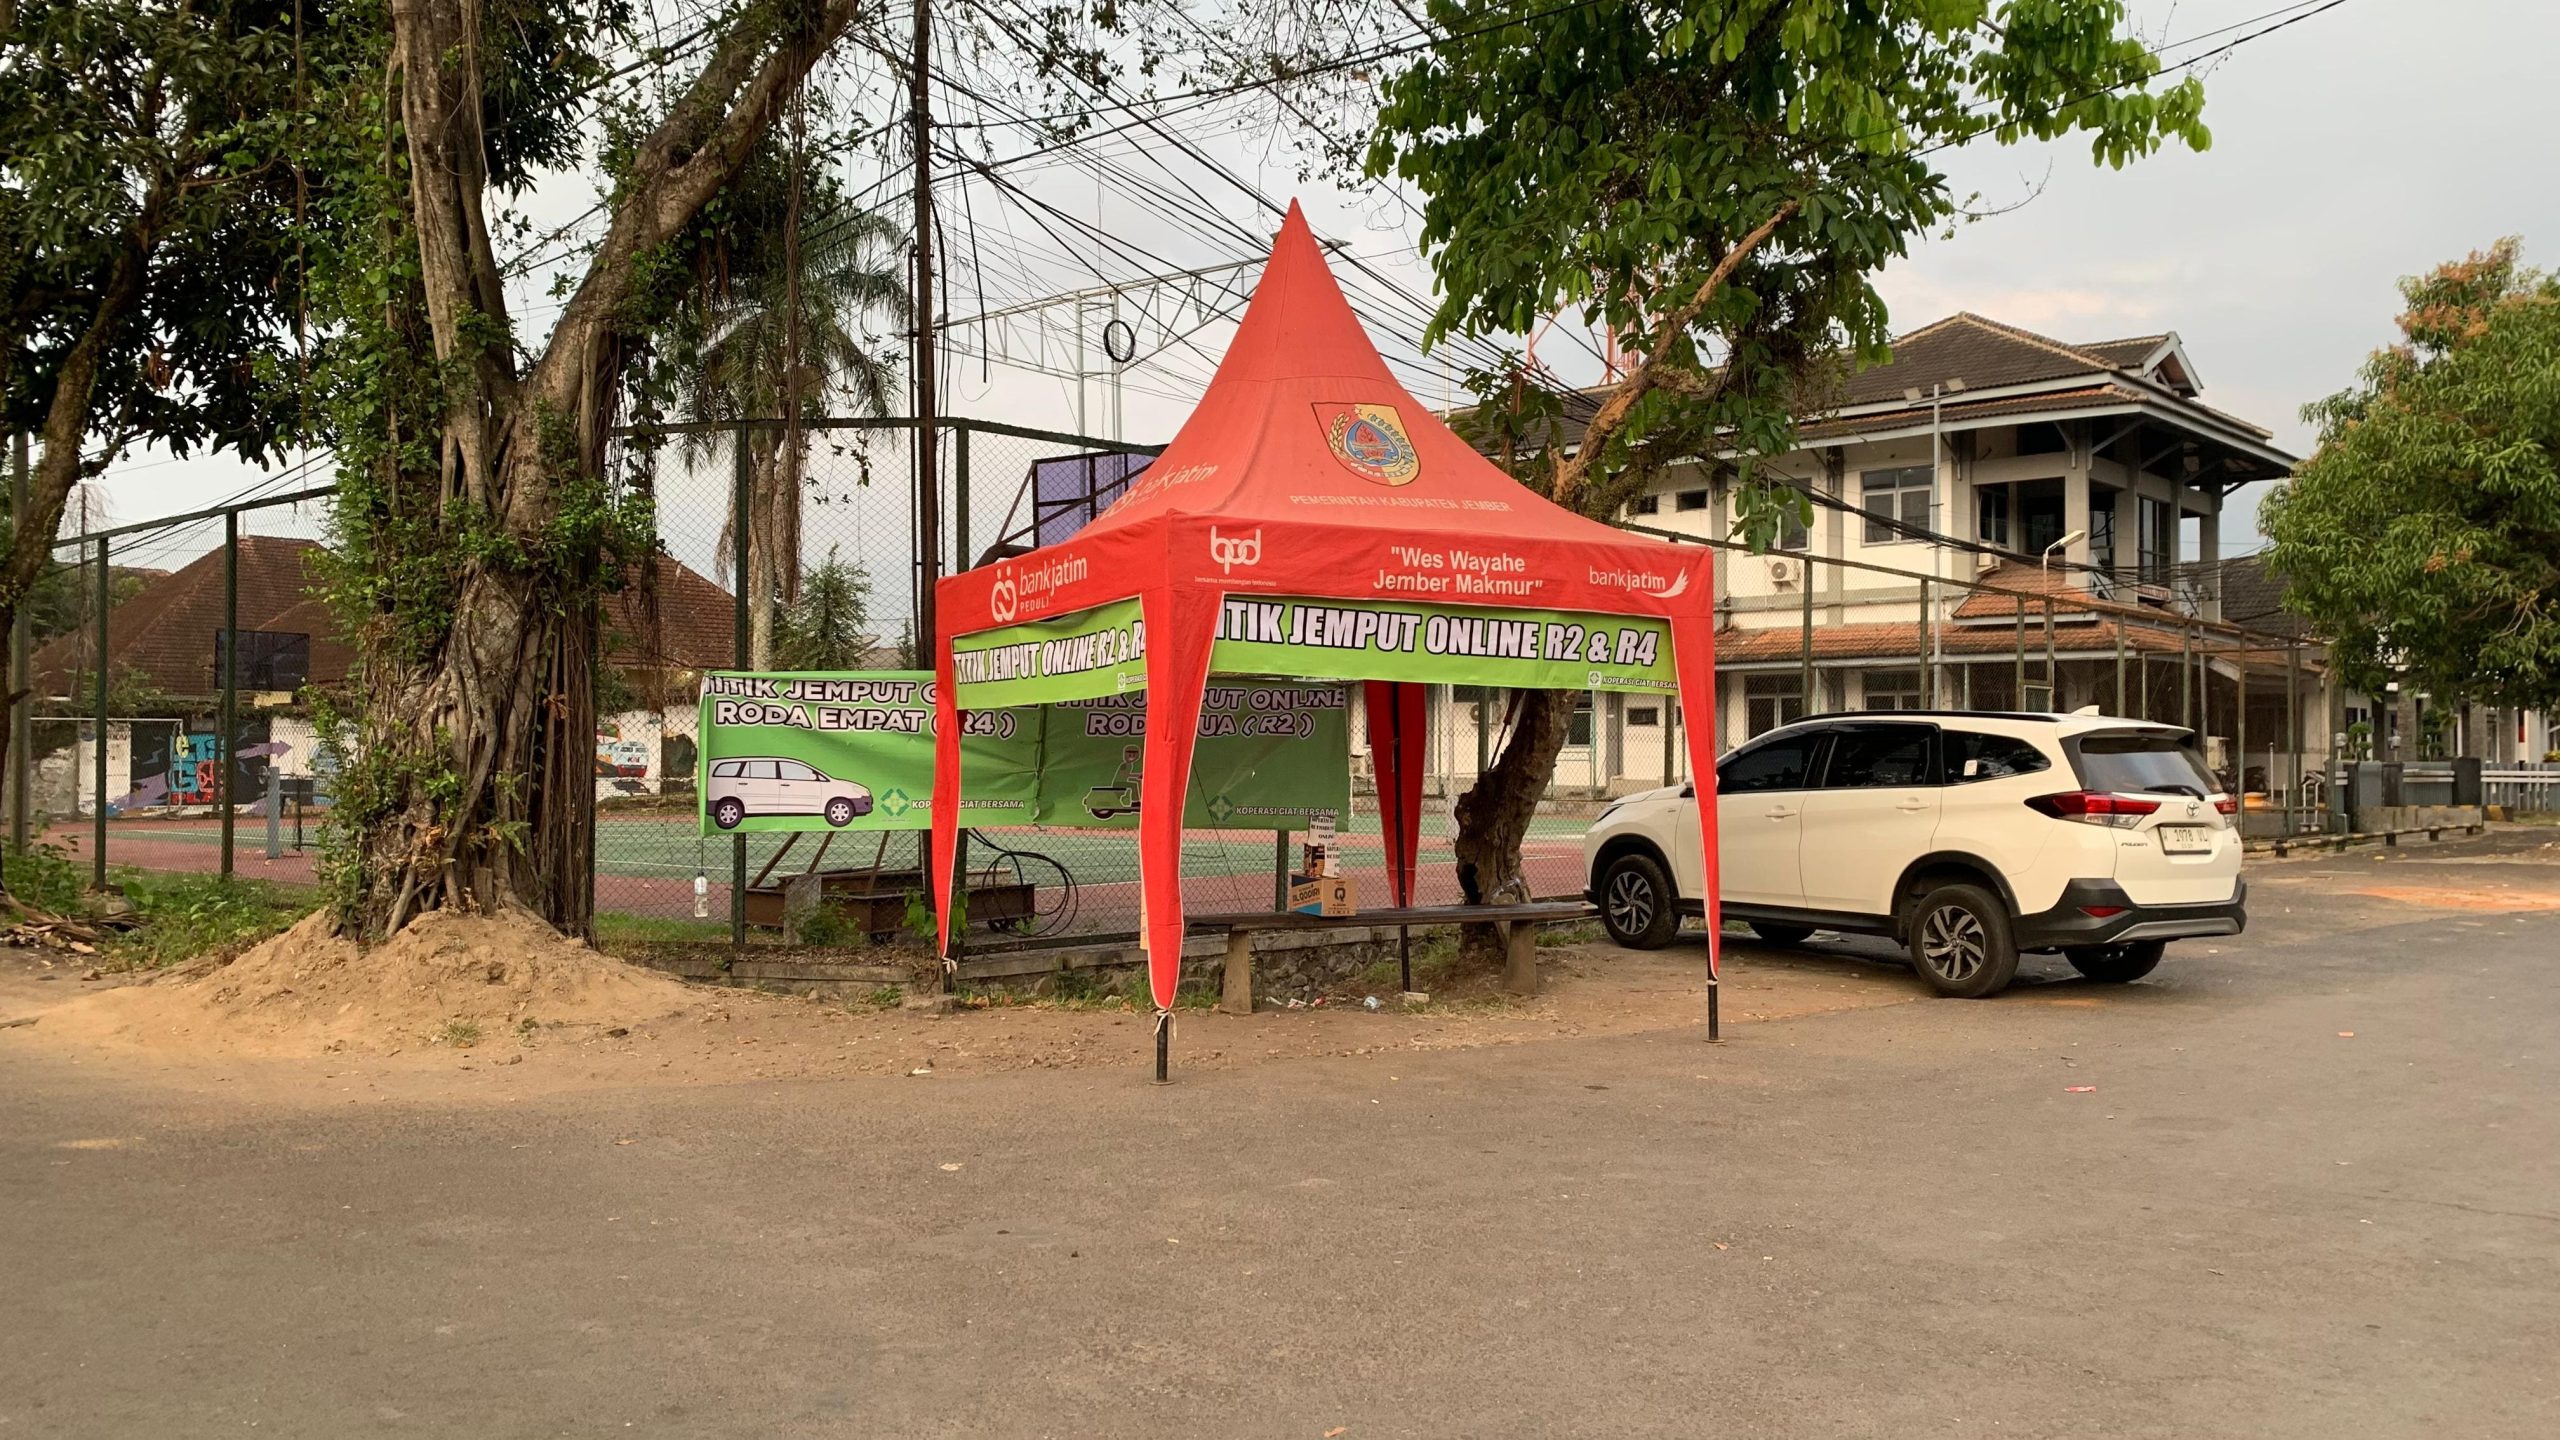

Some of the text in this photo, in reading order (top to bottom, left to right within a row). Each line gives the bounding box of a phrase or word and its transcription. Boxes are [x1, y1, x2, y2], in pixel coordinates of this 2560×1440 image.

[1289, 495, 1514, 512] PEMERINTAH KABUPATEN JEMBER
[1391, 546, 1526, 575] "Wes Wayahe
[1020, 553, 1087, 597] bankjatim
[1373, 569, 1543, 596] Jember Makmur"
[1589, 565, 1666, 592] bankjatim
[1020, 596, 1049, 613] PEDULI
[1289, 604, 1422, 652] JEMPUT
[1425, 614, 1541, 660] ONLINE
[1543, 623, 1585, 662] R2
[1586, 631, 1610, 663] &
[1614, 628, 1659, 666] R4
[953, 652, 987, 684] TITIK
[988, 642, 1041, 682] JEMPUT
[1041, 633, 1097, 677] ONLINE
[1097, 627, 1116, 668] R2
[1118, 629, 1130, 663] &
[784, 680, 918, 704] JEMPUT
[1602, 676, 1634, 685] KOPERASI
[1635, 679, 1650, 687] GIAT
[1249, 688, 1345, 711] ONLINE
[715, 700, 813, 730] RODA
[817, 706, 927, 734] EMPAT
[1088, 713, 1147, 736] ROD
[1197, 715, 1236, 736] UA
[960, 800, 1025, 809] GIAT BERSAMA
[1235, 806, 1339, 816] KOPERASI GIAT BERSAMA
[2174, 829, 2194, 842] 1978
